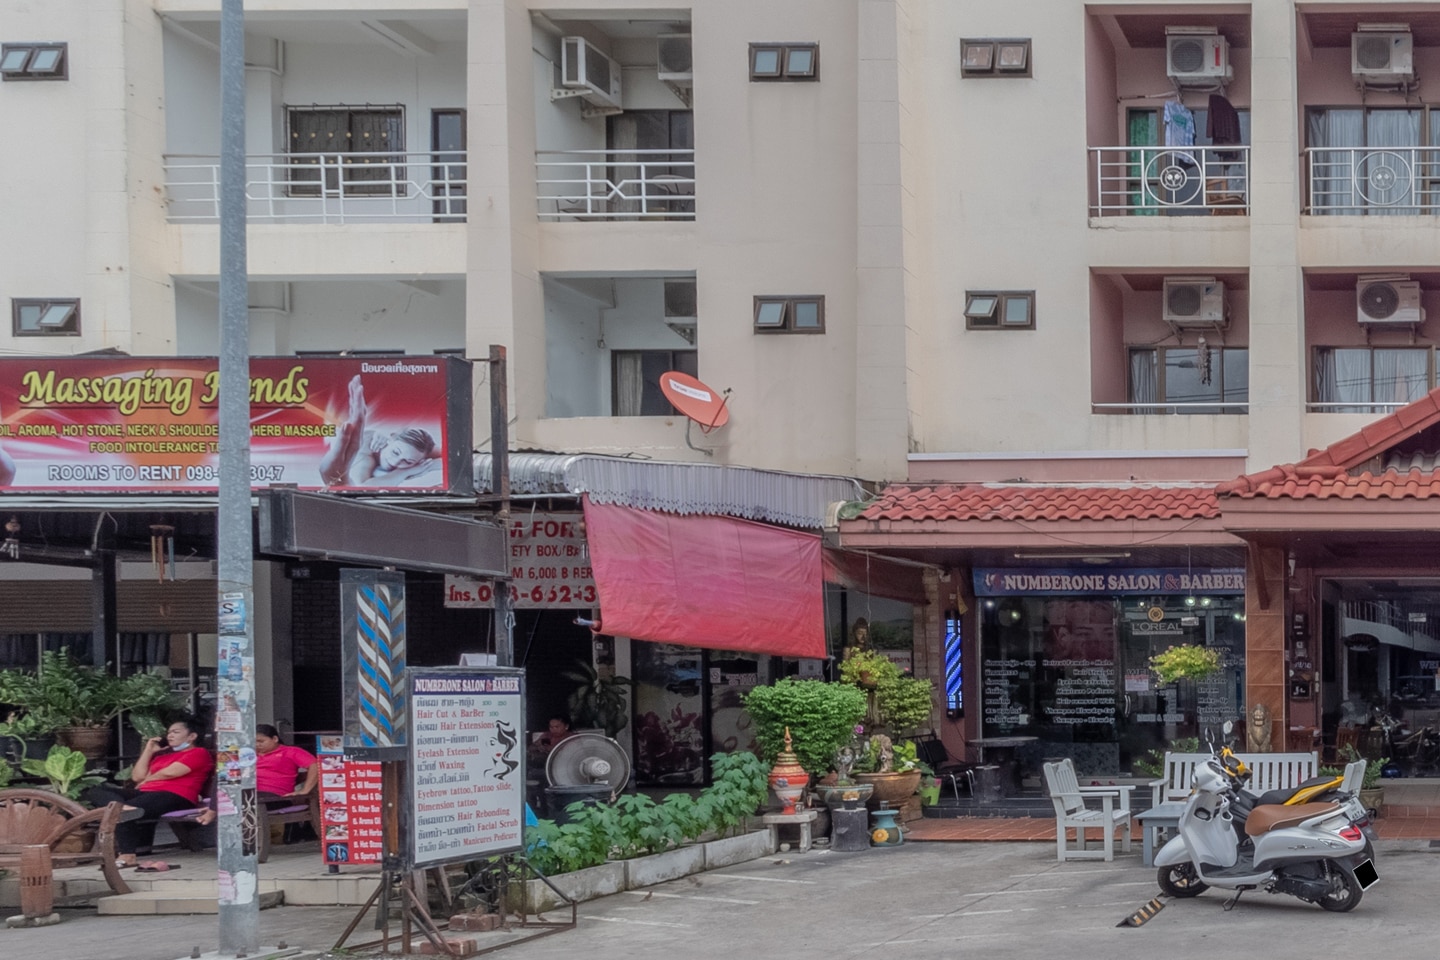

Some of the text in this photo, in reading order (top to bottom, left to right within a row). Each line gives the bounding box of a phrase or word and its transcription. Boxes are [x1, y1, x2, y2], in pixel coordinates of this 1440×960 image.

[18, 366, 309, 416] Massaging Hnds
[18, 424, 60, 438] AROMA,
[62, 424, 84, 437] HOT
[127, 424, 156, 437] NECK
[159, 424, 167, 437] &
[169, 424, 219, 437] SHOULDE
[252, 424, 282, 437] HERB
[284, 424, 337, 437] MASSAGE
[90, 442, 123, 454] FOOD
[125, 442, 206, 454] INTOLERANCE
[48, 465, 285, 481] ROOMS TO RENT 098-3047
[562, 567, 569, 579] B
[1003, 574, 1245, 590] NUMBERONE SALON & BARBER
[415, 679, 461, 692] NUMBERONE
[462, 679, 485, 692] SALON
[493, 679, 519, 692] BARBER
[417, 709, 434, 719] Hair
[436, 709, 449, 719] Cut
[440, 721, 457, 731] Hair
[459, 721, 495, 730] Extensions
[417, 746, 480, 760] Eyelash Extension
[439, 760, 465, 771] Waxing
[417, 788, 447, 800] Eyebrow
[417, 799, 478, 812] Dimension tattoo
[457, 812, 473, 821] Hair
[475, 808, 510, 819] Rebonding
[477, 821, 497, 831] Facial
[499, 818, 518, 828] Scrub
[494, 832, 518, 842] Pedicure
